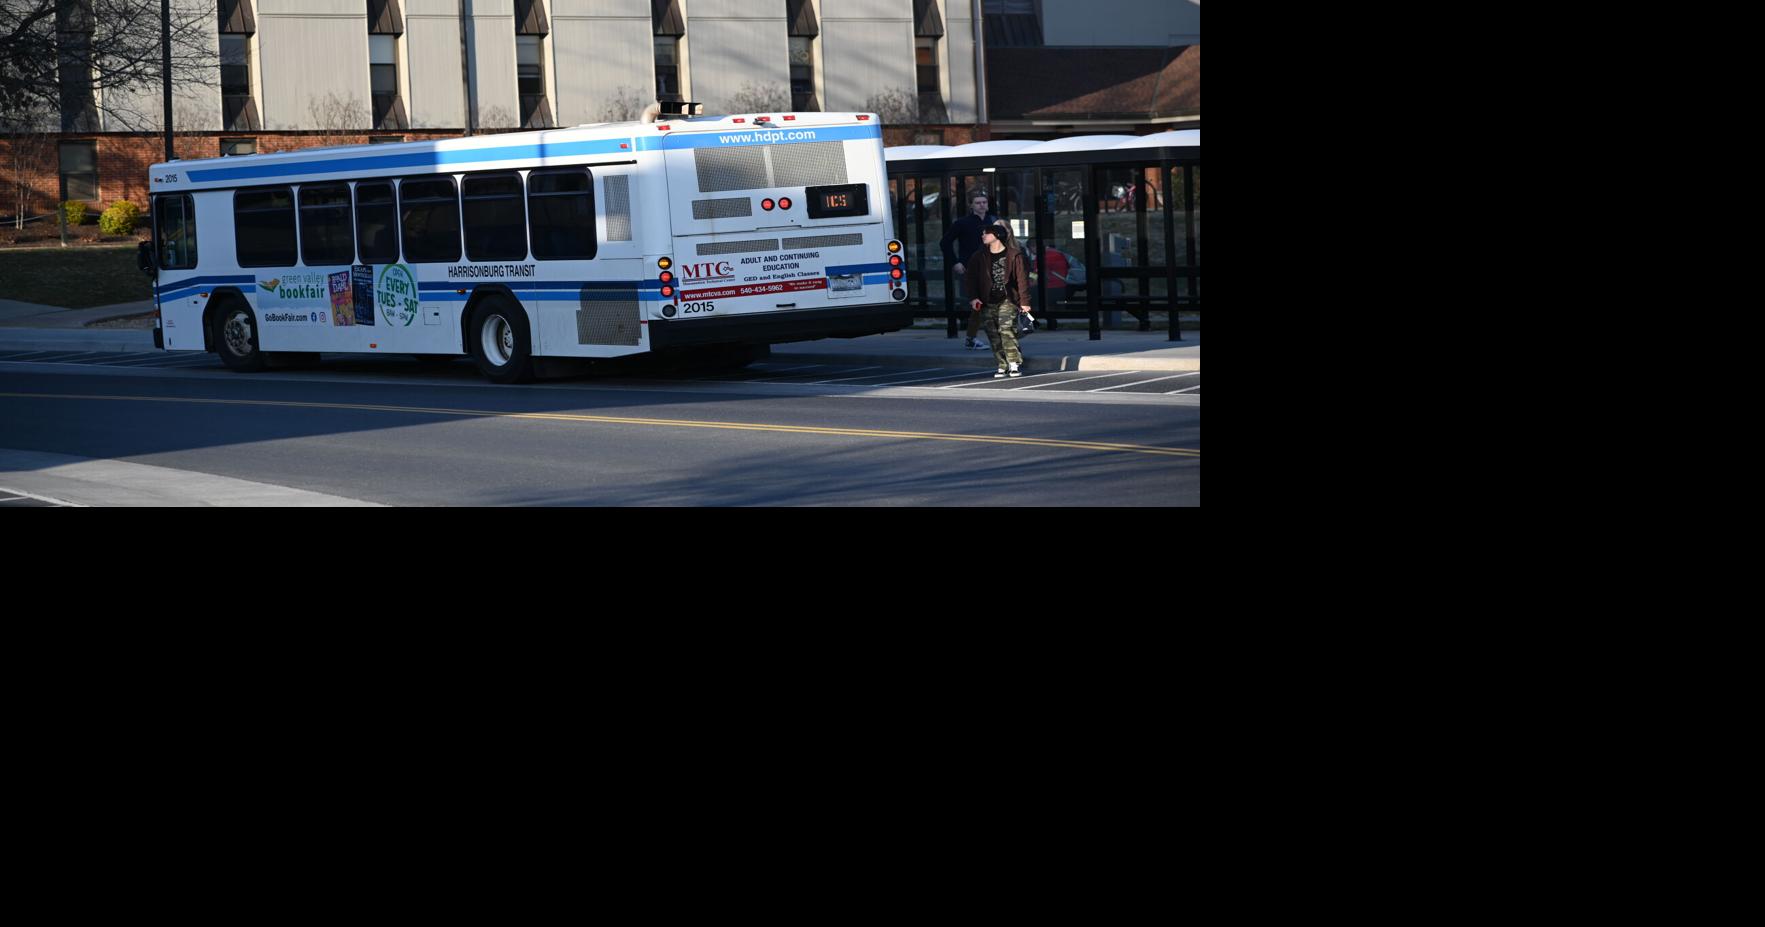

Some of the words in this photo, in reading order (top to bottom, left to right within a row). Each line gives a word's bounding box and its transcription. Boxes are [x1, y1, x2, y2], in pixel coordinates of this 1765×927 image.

[719, 130, 816, 144] www.hdpt.com
[165, 174, 177, 183] 2015
[741, 256, 762, 264] ADULT
[764, 255, 778, 263] AND
[780, 252, 820, 261] CONTINUING
[448, 265, 504, 278] HARRISONBURG
[505, 264, 535, 277] TRANSIT
[682, 261, 730, 278] MTC
[763, 262, 800, 271] EDUCATION
[281, 274, 302, 286] green
[303, 272, 324, 284] valley
[773, 272, 796, 280] English
[279, 284, 325, 298] bookfair
[386, 276, 409, 295] EVERY
[684, 290, 736, 299] www.mtcva.com
[740, 284, 784, 294] 540-434-5962
[377, 290, 396, 307] TUES
[403, 297, 418, 314] SAT
[683, 301, 715, 313] 2015
[264, 313, 308, 322] GoBookFair.com
